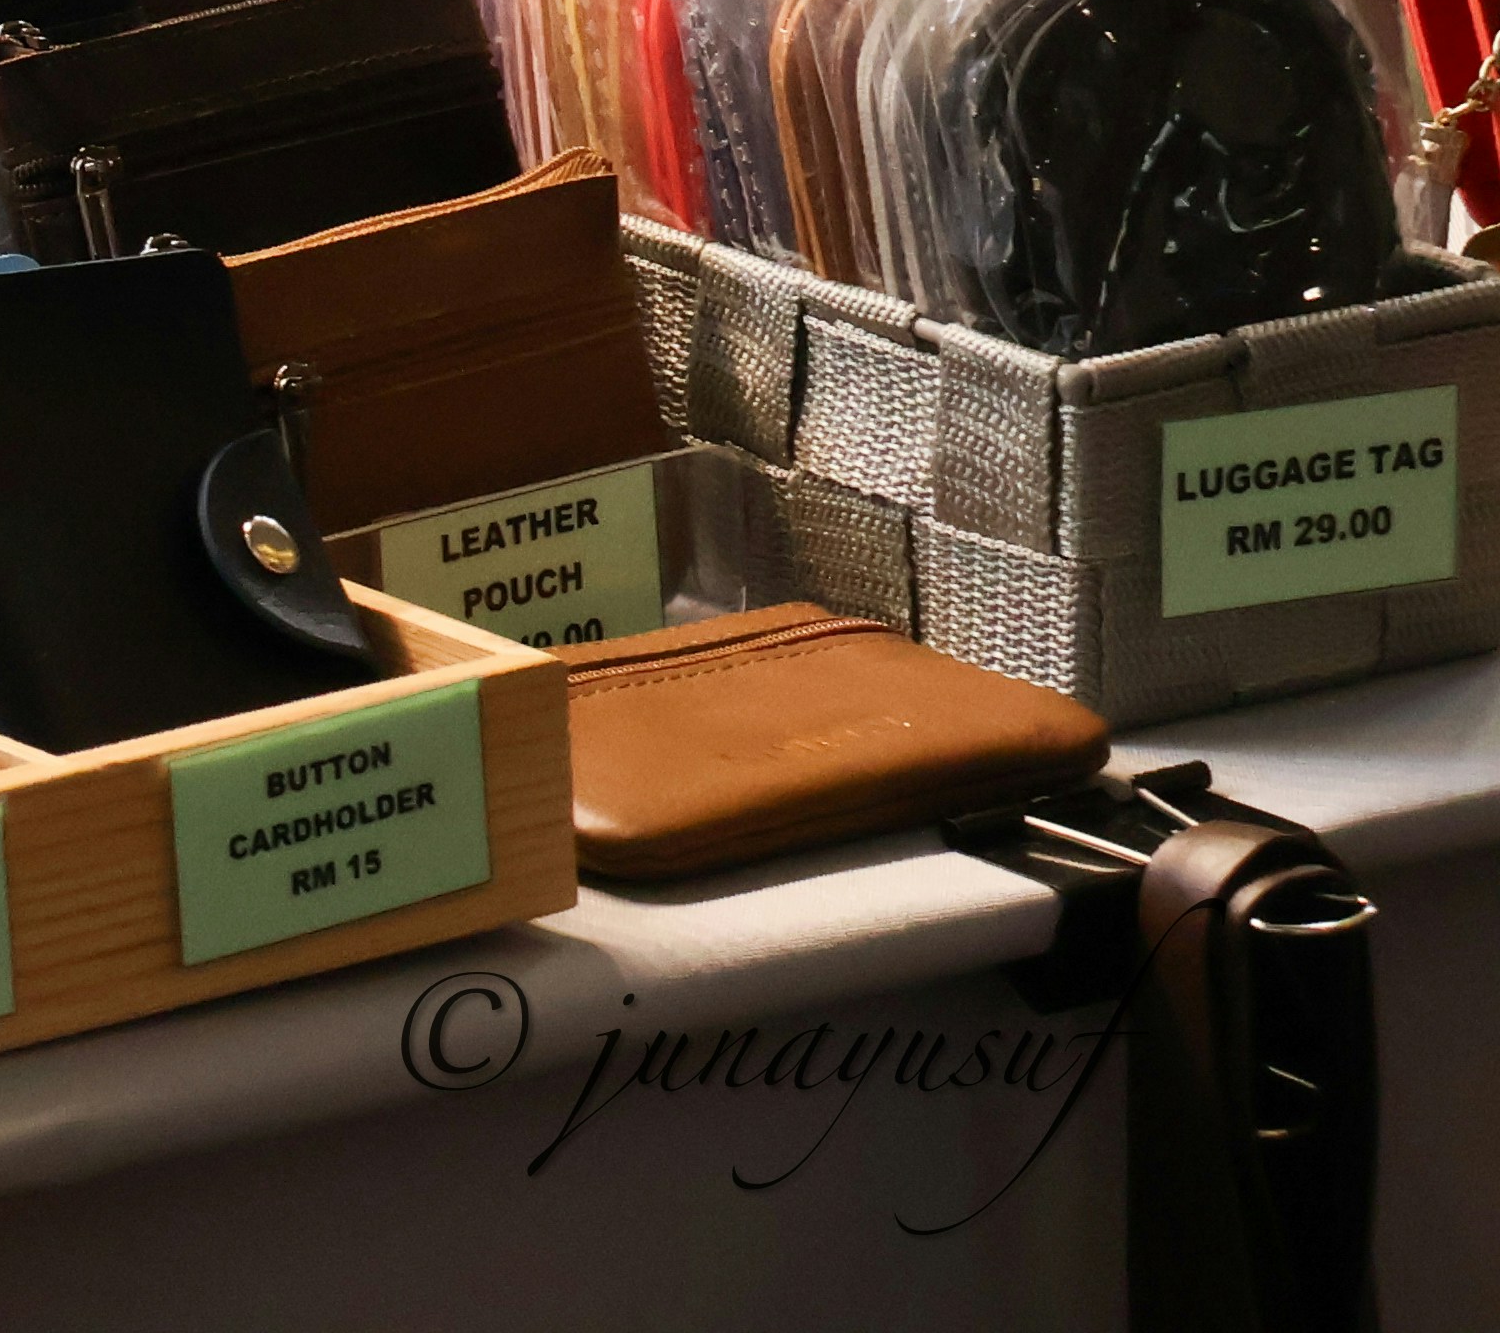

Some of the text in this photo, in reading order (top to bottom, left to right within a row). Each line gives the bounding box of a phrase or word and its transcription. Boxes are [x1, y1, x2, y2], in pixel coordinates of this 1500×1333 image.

[1177, 437, 1444, 502] LUGGAGE TAG
[441, 497, 599, 563] LEATHER
[1227, 505, 1392, 556] RM 29.00
[463, 561, 583, 619] POUCH
[266, 741, 392, 799] BUTTON
[228, 782, 436, 860] CARDHOLDER
[291, 849, 382, 895] RM 15
